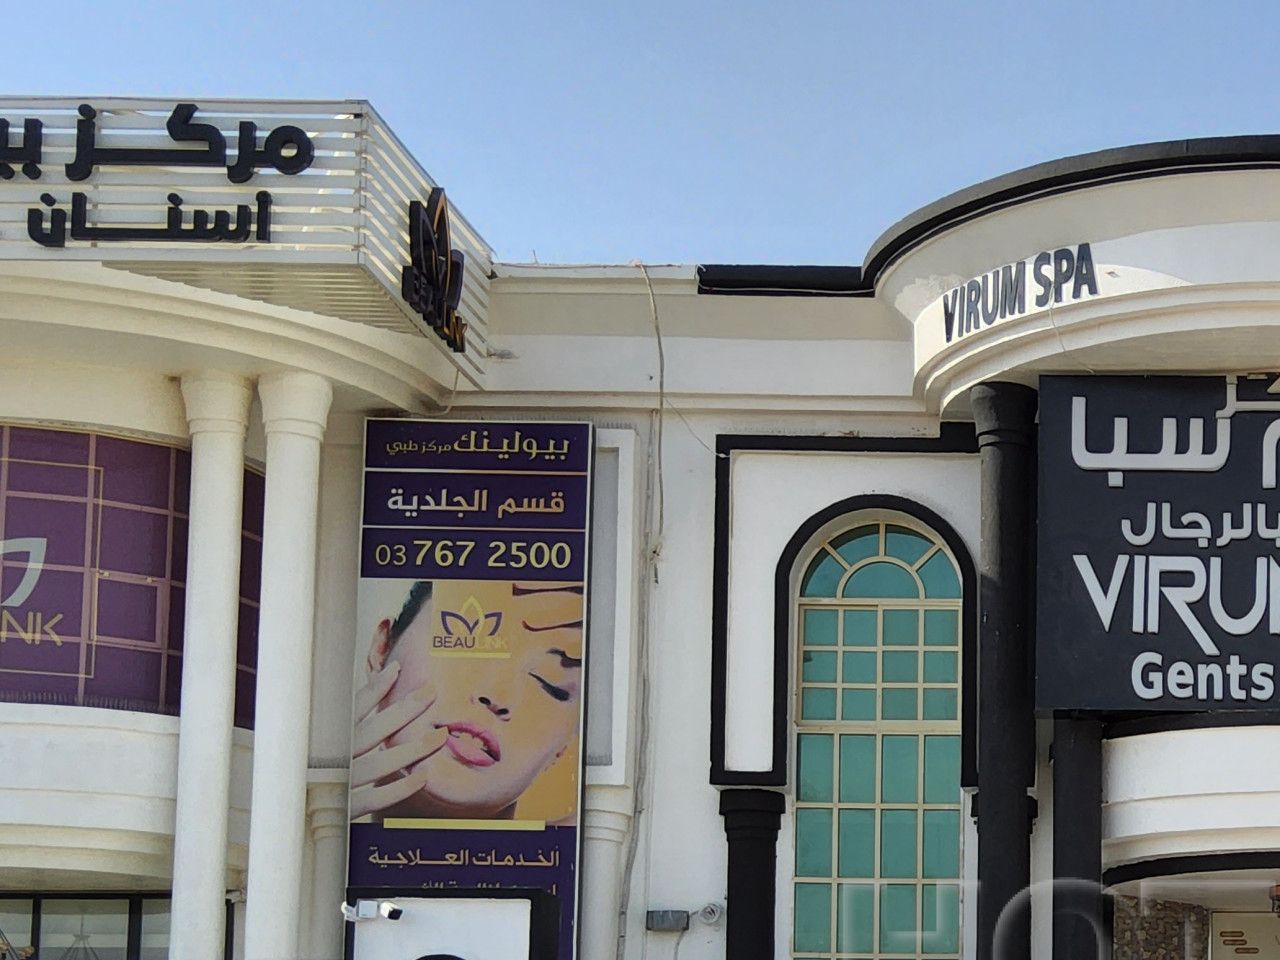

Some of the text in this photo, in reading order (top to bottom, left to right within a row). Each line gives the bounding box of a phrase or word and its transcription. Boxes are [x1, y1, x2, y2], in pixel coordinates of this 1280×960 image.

[65, 103, 315, 183] مركز
[943, 242, 1098, 343] VIRUM SPA
[385, 430, 570, 460] بيولينك مركز طبي
[1071, 397, 1231, 488] سبا
[387, 487, 565, 519] قسم الجلدية
[375, 540, 572, 569] 03 767 2500
[1131, 651, 1275, 702] Gents
[368, 846, 560, 869] الخدمات العلاجية
